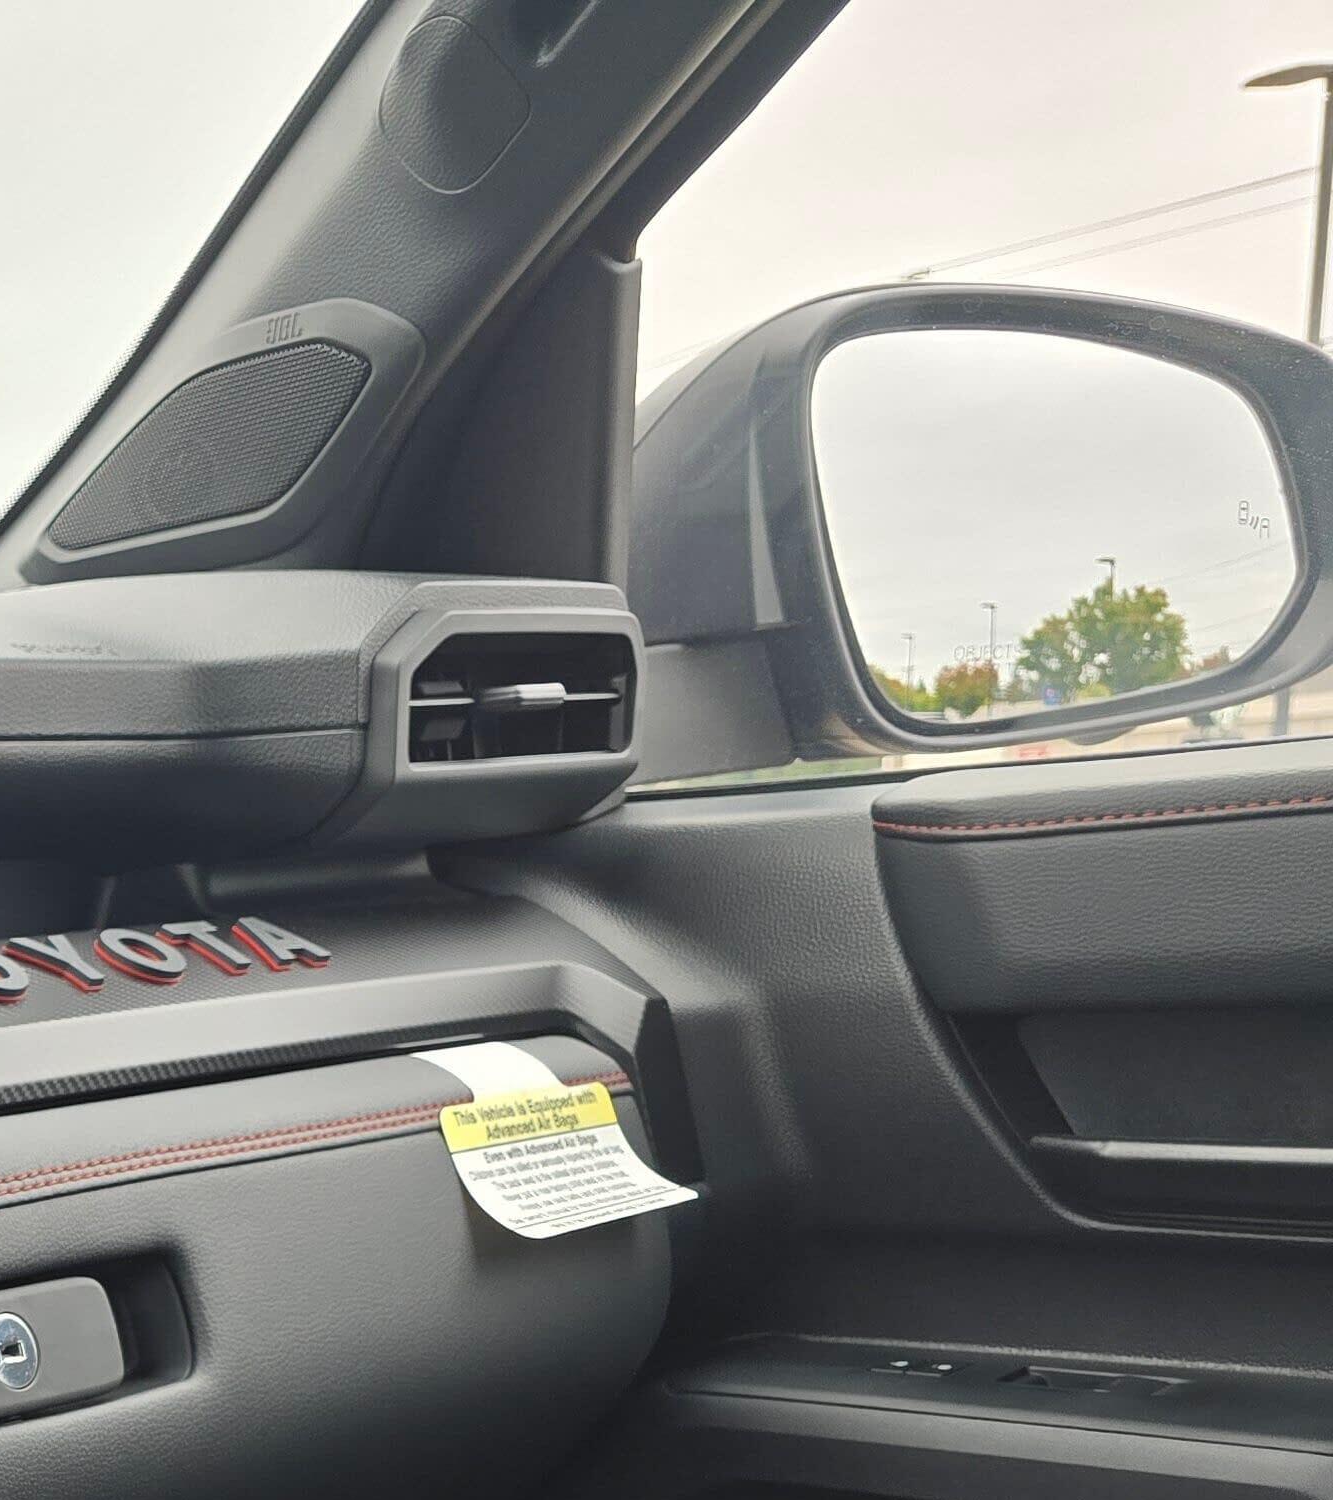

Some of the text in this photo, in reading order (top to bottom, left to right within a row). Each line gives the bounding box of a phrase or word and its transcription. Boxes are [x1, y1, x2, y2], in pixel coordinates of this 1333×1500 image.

[453, 1089, 599, 1126] This Vehicle is Equipped with
[486, 1112, 579, 1140] Advanced Air Bags
